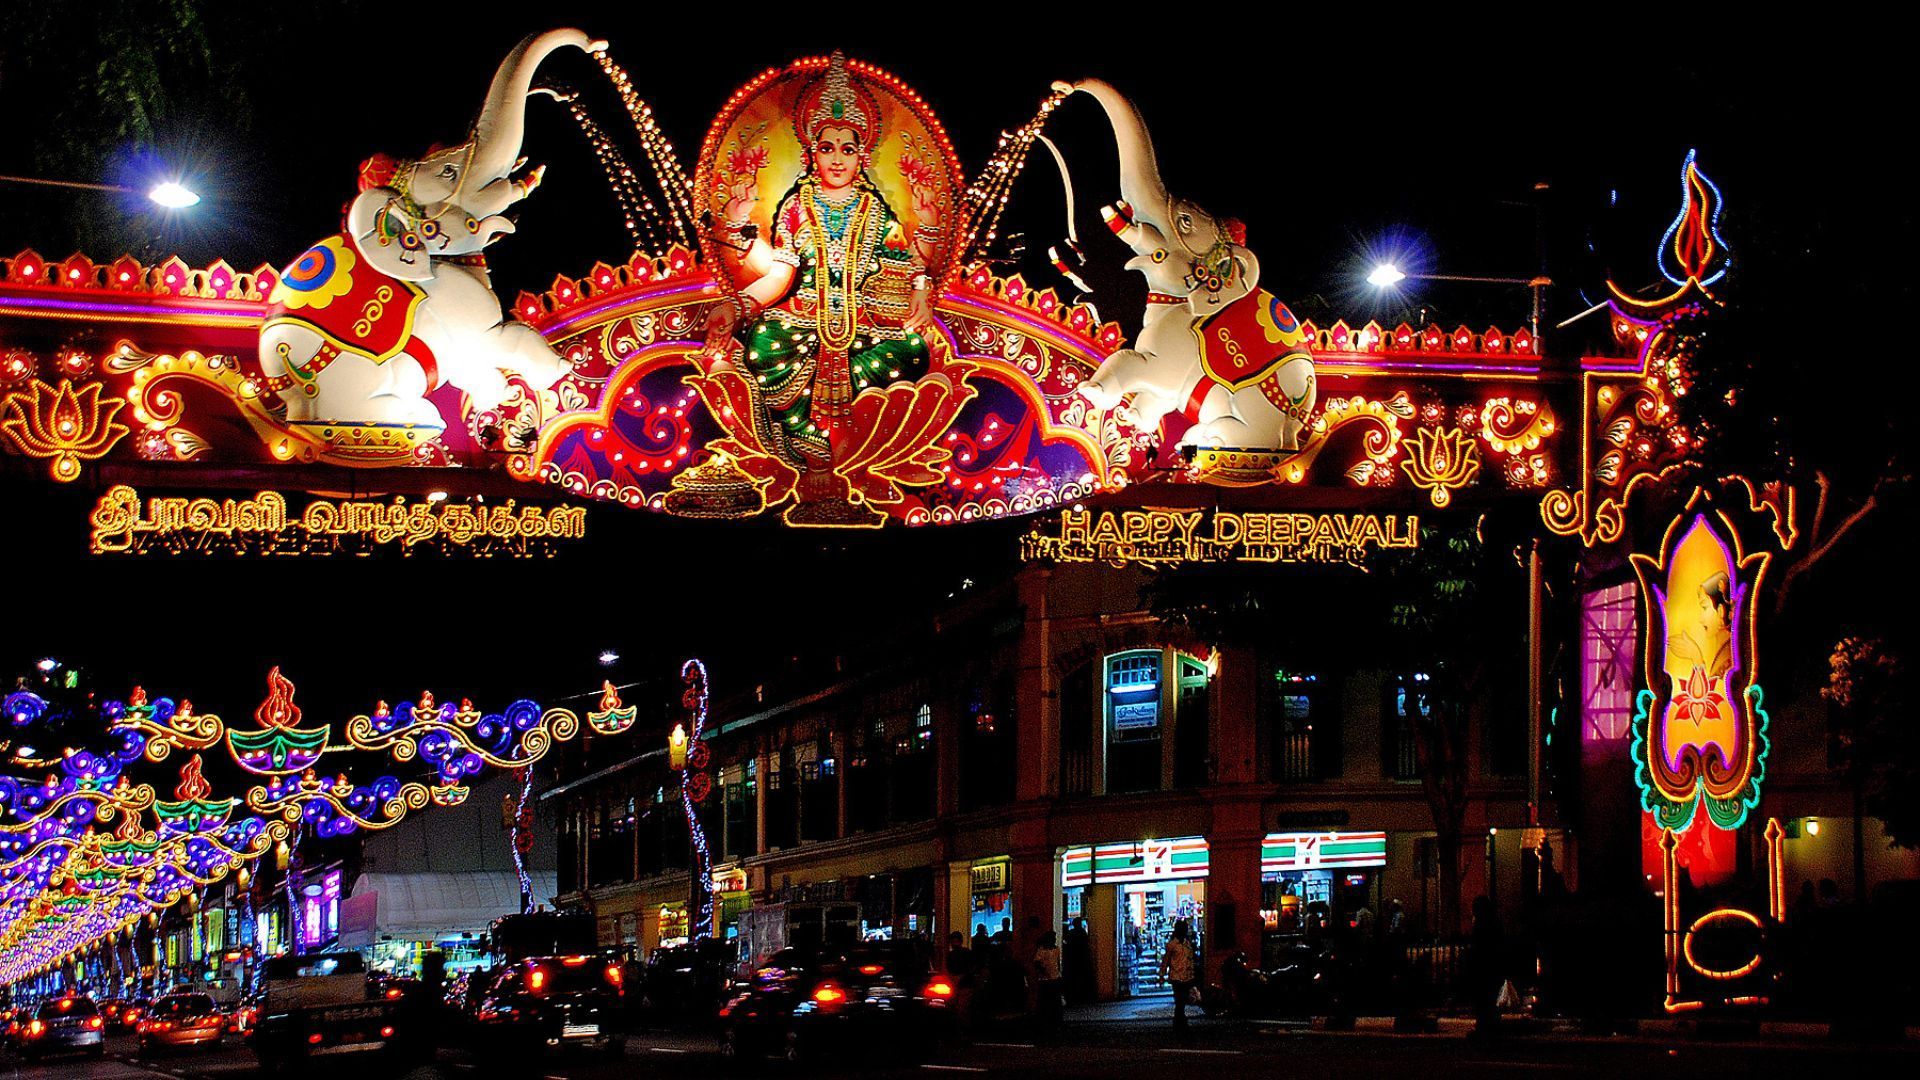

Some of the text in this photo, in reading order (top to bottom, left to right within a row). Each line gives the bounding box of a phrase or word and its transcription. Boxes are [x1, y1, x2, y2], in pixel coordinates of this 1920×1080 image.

[91, 485, 287, 550] தீபாவளி
[1060, 509, 1419, 548] HAPPY DEEPAVALI
